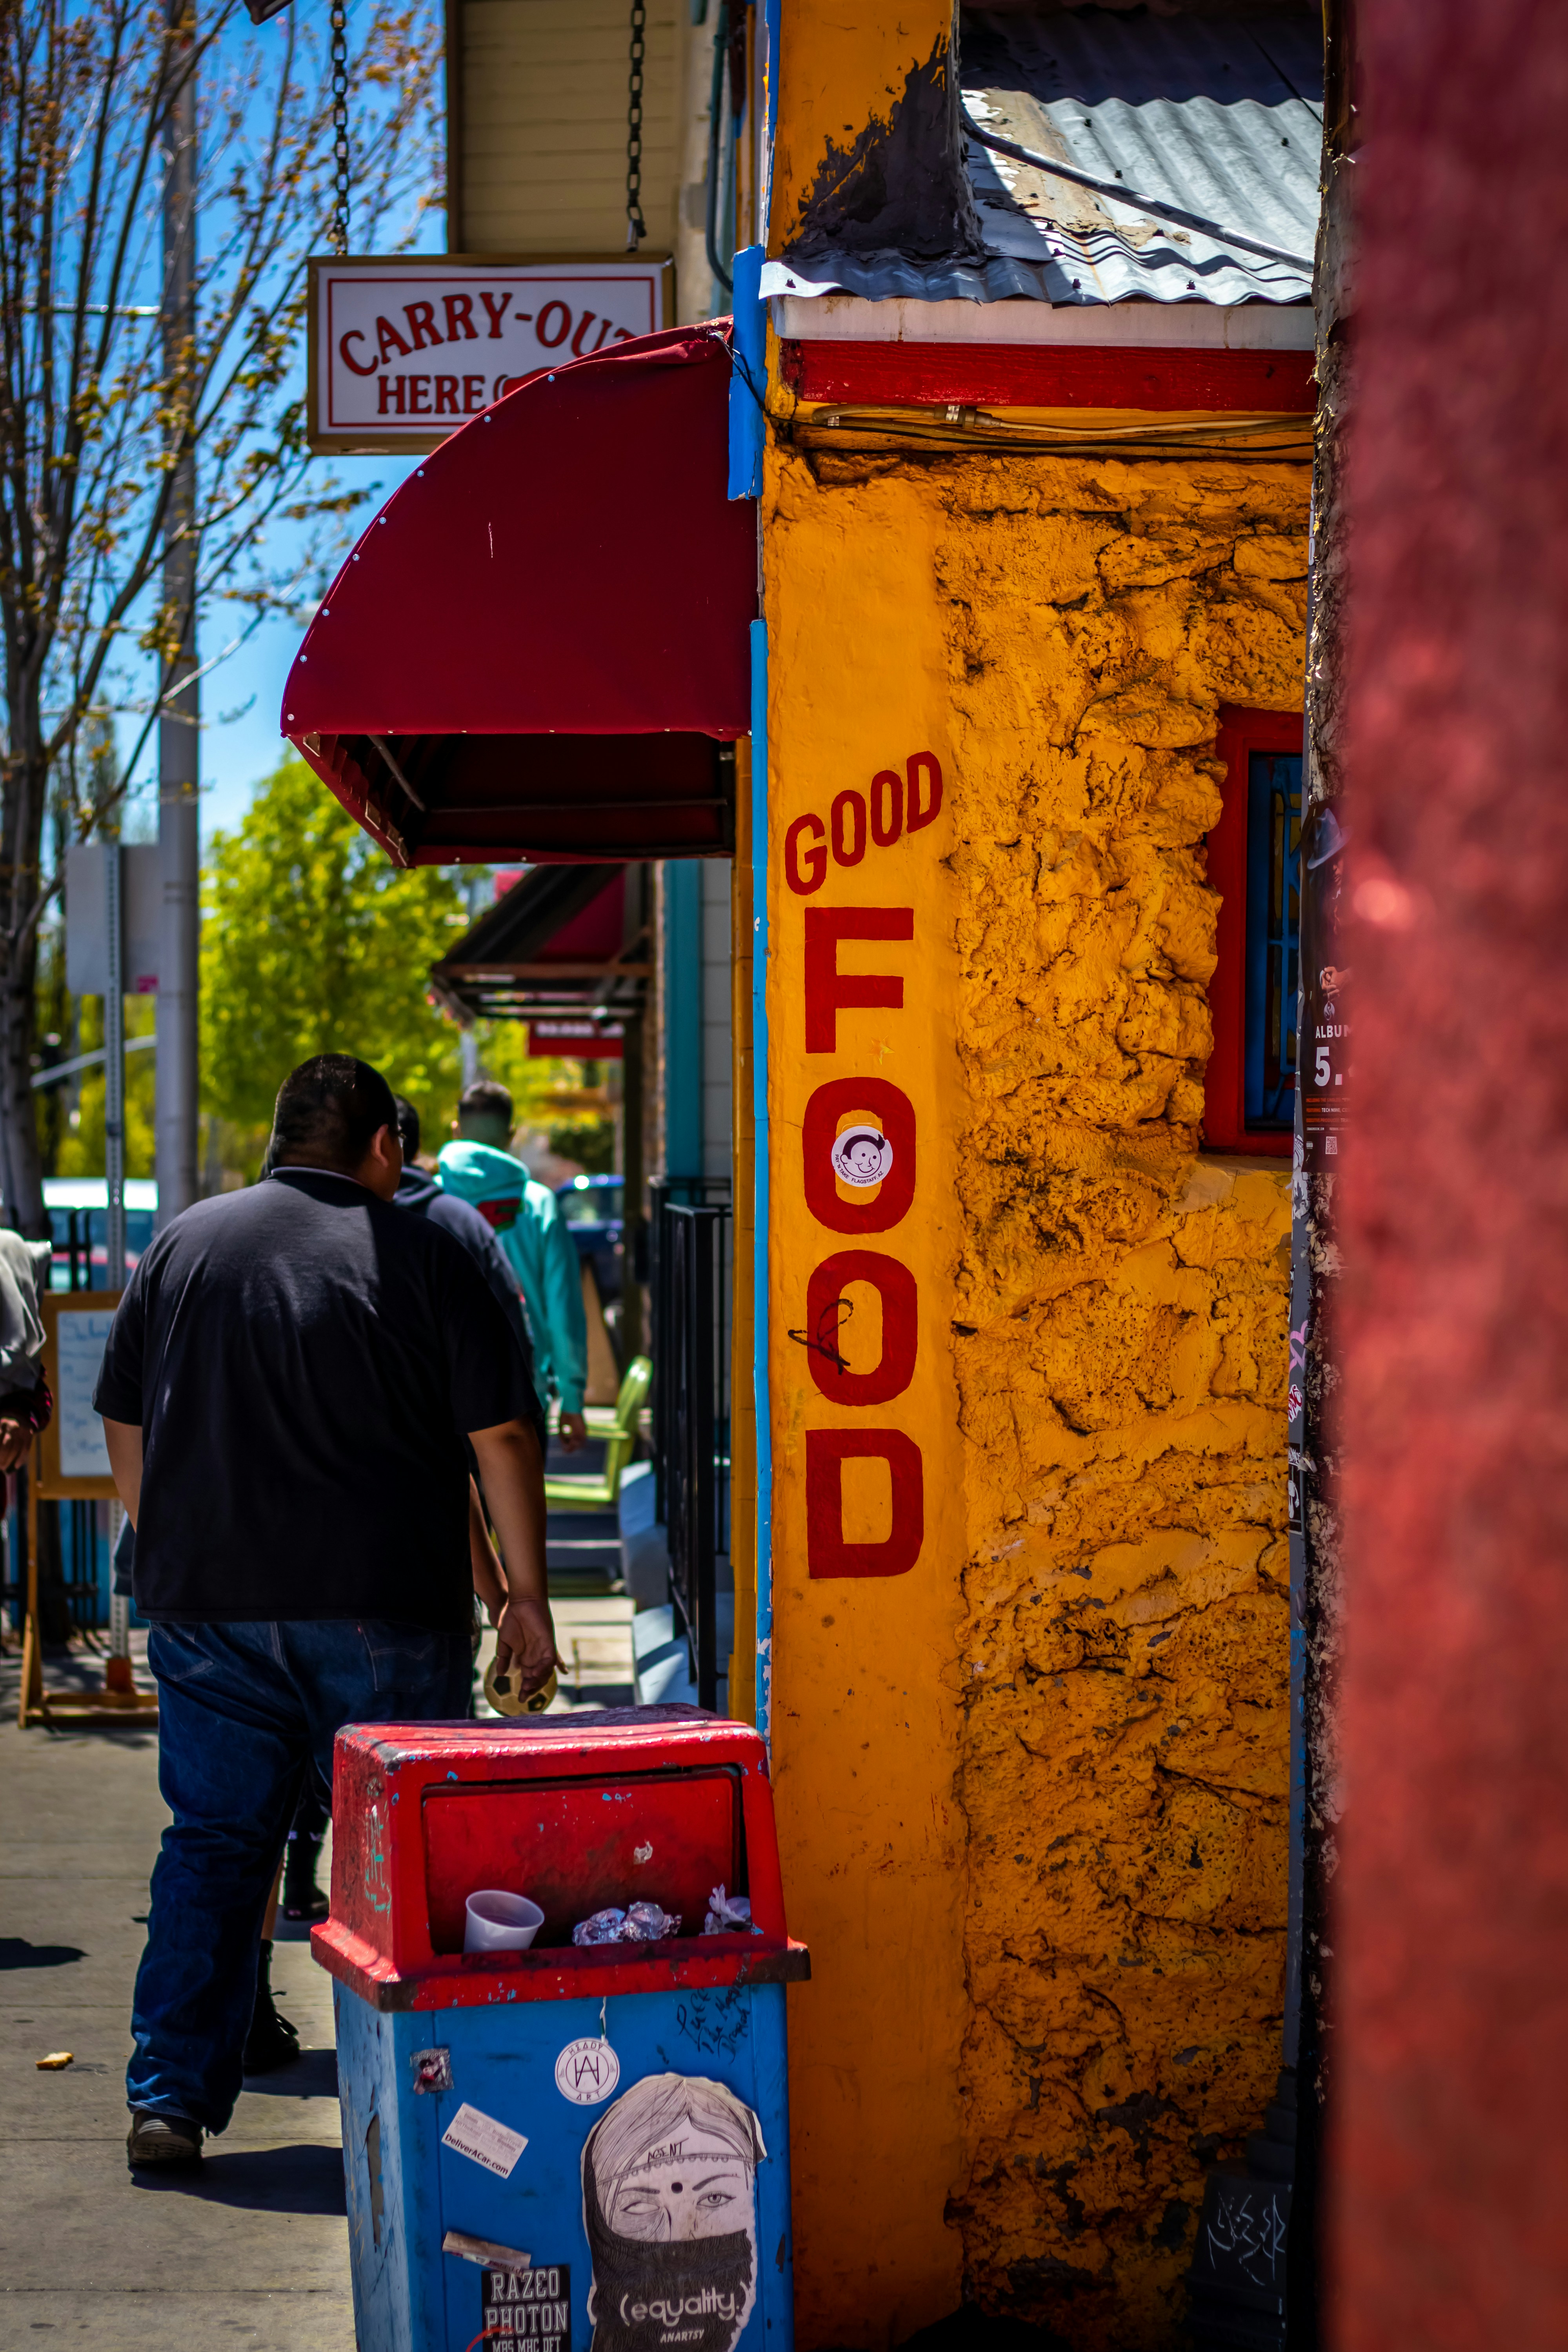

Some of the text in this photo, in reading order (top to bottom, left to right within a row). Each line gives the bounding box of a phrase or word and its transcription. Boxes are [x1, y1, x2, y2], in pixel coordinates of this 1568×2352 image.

[377, 375, 486, 415] HERE
[785, 751, 943, 895] GOOD
[839, 1168, 849, 1179] TAKE
[802, 907, 924, 1579] FOOD
[445, 2134, 509, 2175] DeliverACar.com
[485, 2301, 568, 2338] PHOTON
[660, 2329, 705, 2343] ANARTSY
